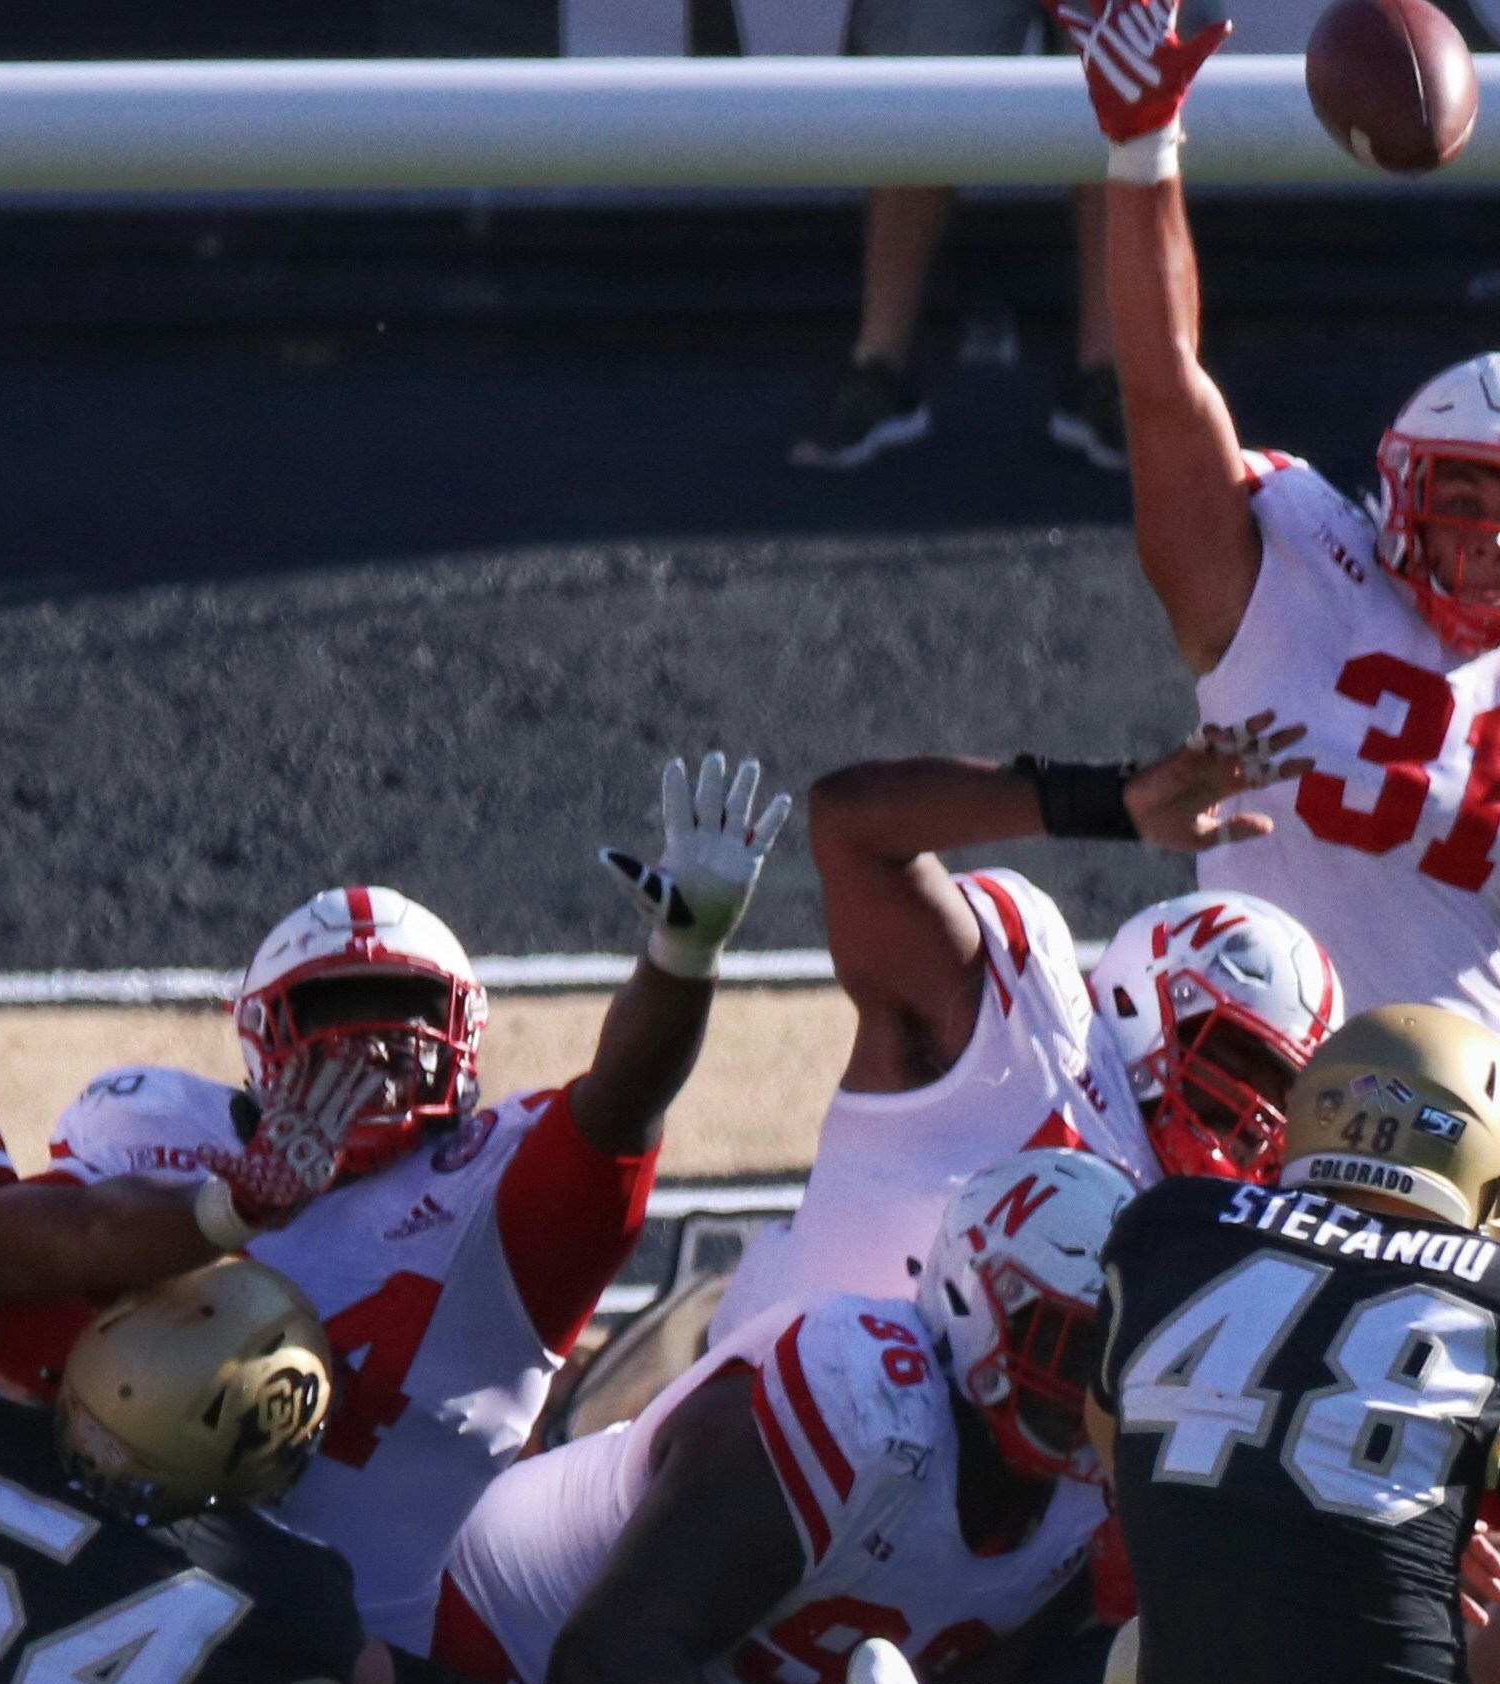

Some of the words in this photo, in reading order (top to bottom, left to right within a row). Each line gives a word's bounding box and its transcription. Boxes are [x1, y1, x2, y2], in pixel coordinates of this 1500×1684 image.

[1340, 1110, 1400, 1154] 48
[1307, 1157, 1416, 1195] COLORADO
[1217, 1184, 1500, 1283] STEFANOU
[1115, 1247, 1499, 1527] 48
